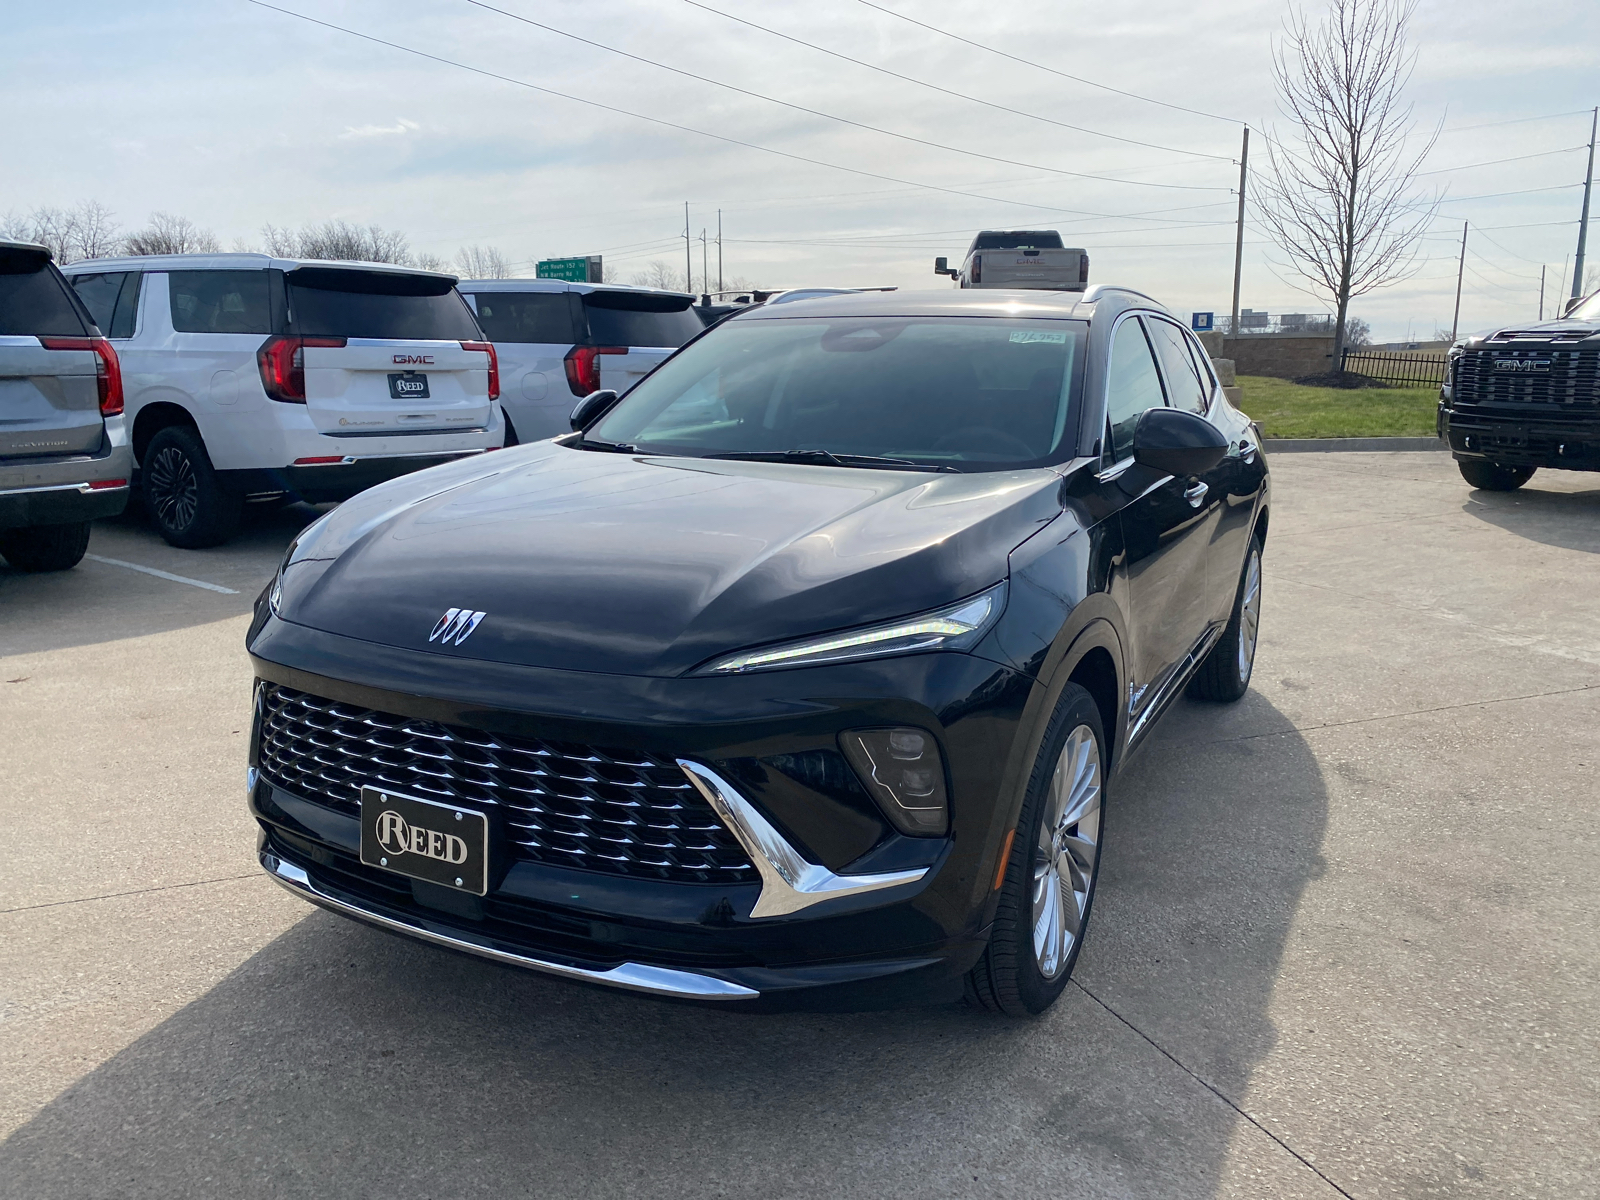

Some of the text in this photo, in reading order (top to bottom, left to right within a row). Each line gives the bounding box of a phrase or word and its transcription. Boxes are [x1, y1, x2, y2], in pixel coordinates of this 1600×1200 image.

[550, 271, 564, 279] Barry
[393, 354, 435, 364] GMC
[1494, 359, 1551, 372] GMC
